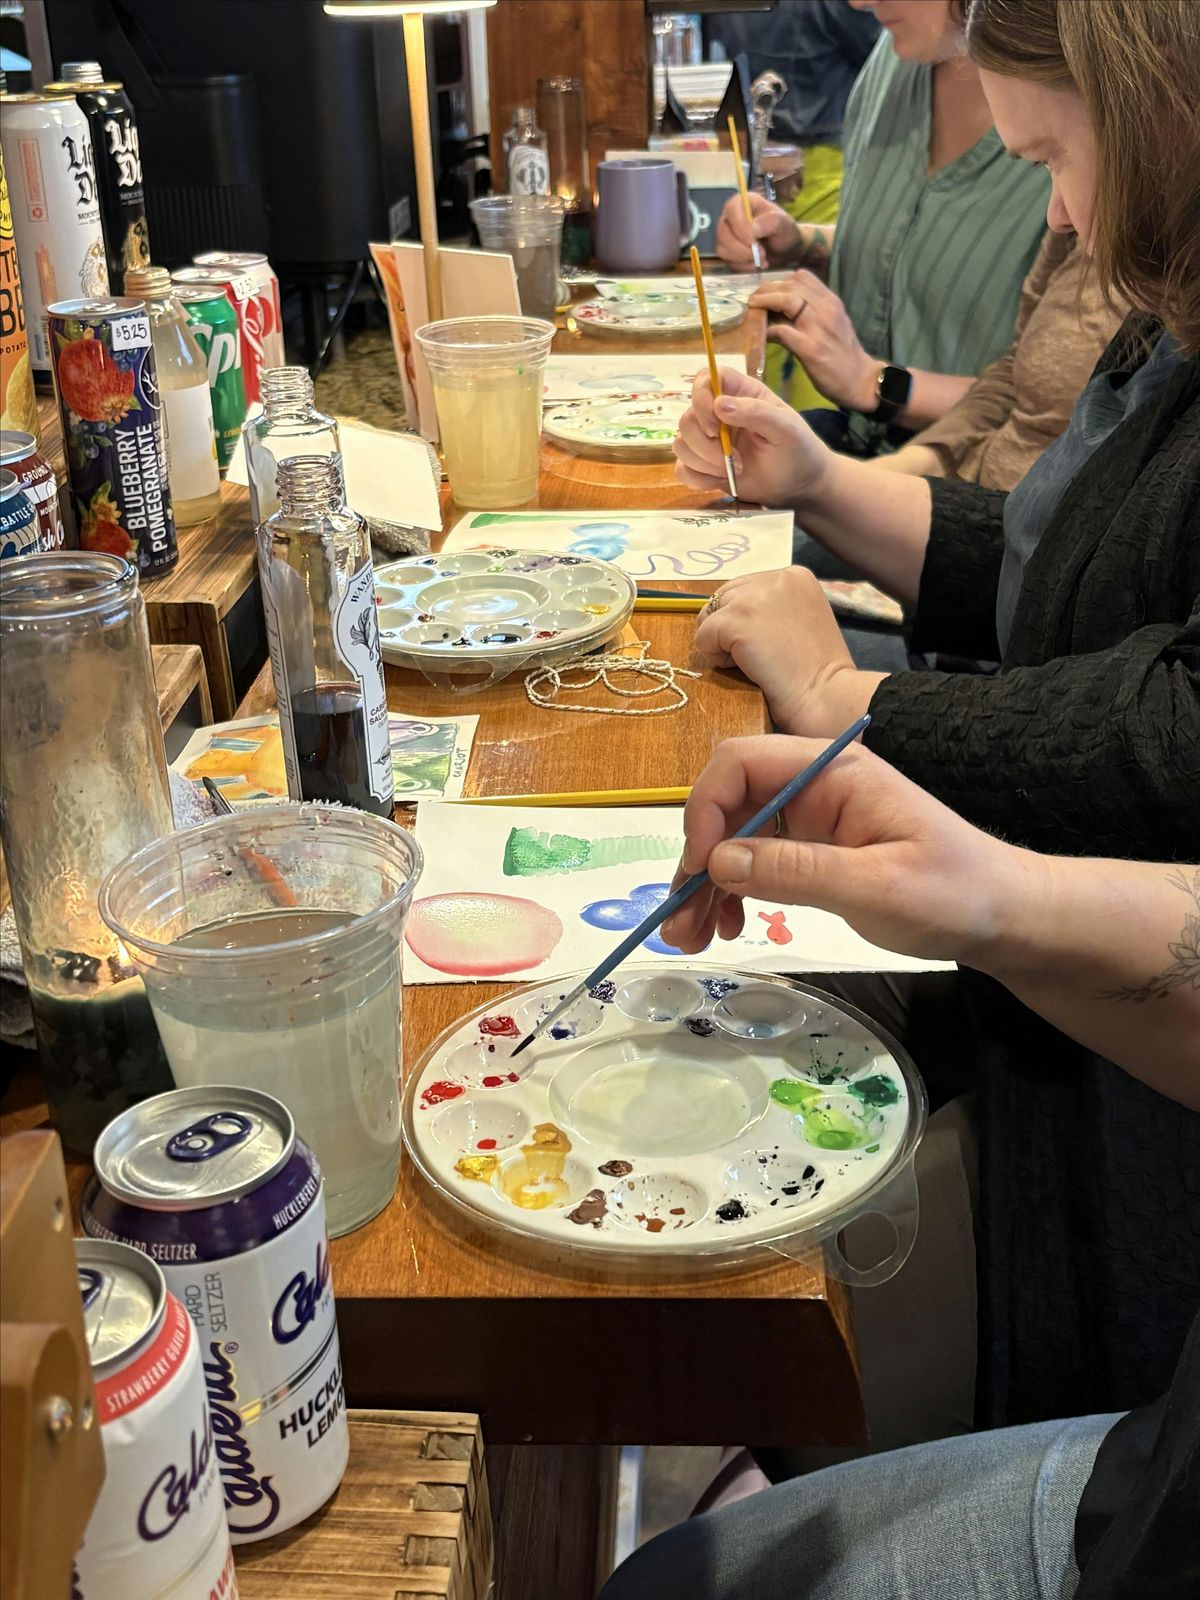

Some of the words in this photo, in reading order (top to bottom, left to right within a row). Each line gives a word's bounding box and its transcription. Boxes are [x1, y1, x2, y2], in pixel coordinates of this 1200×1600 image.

[115, 323, 147, 341] $5.25
[115, 429, 147, 530] BLUEBERRY
[137, 423, 168, 552] POMEGRANATE
[273, 1175, 318, 1230] HUCKLEBERRY
[151, 1243, 197, 1261] SELTZER
[205, 1271, 228, 1333] SELTZER
[106, 1356, 171, 1413] STRAWBERRY
